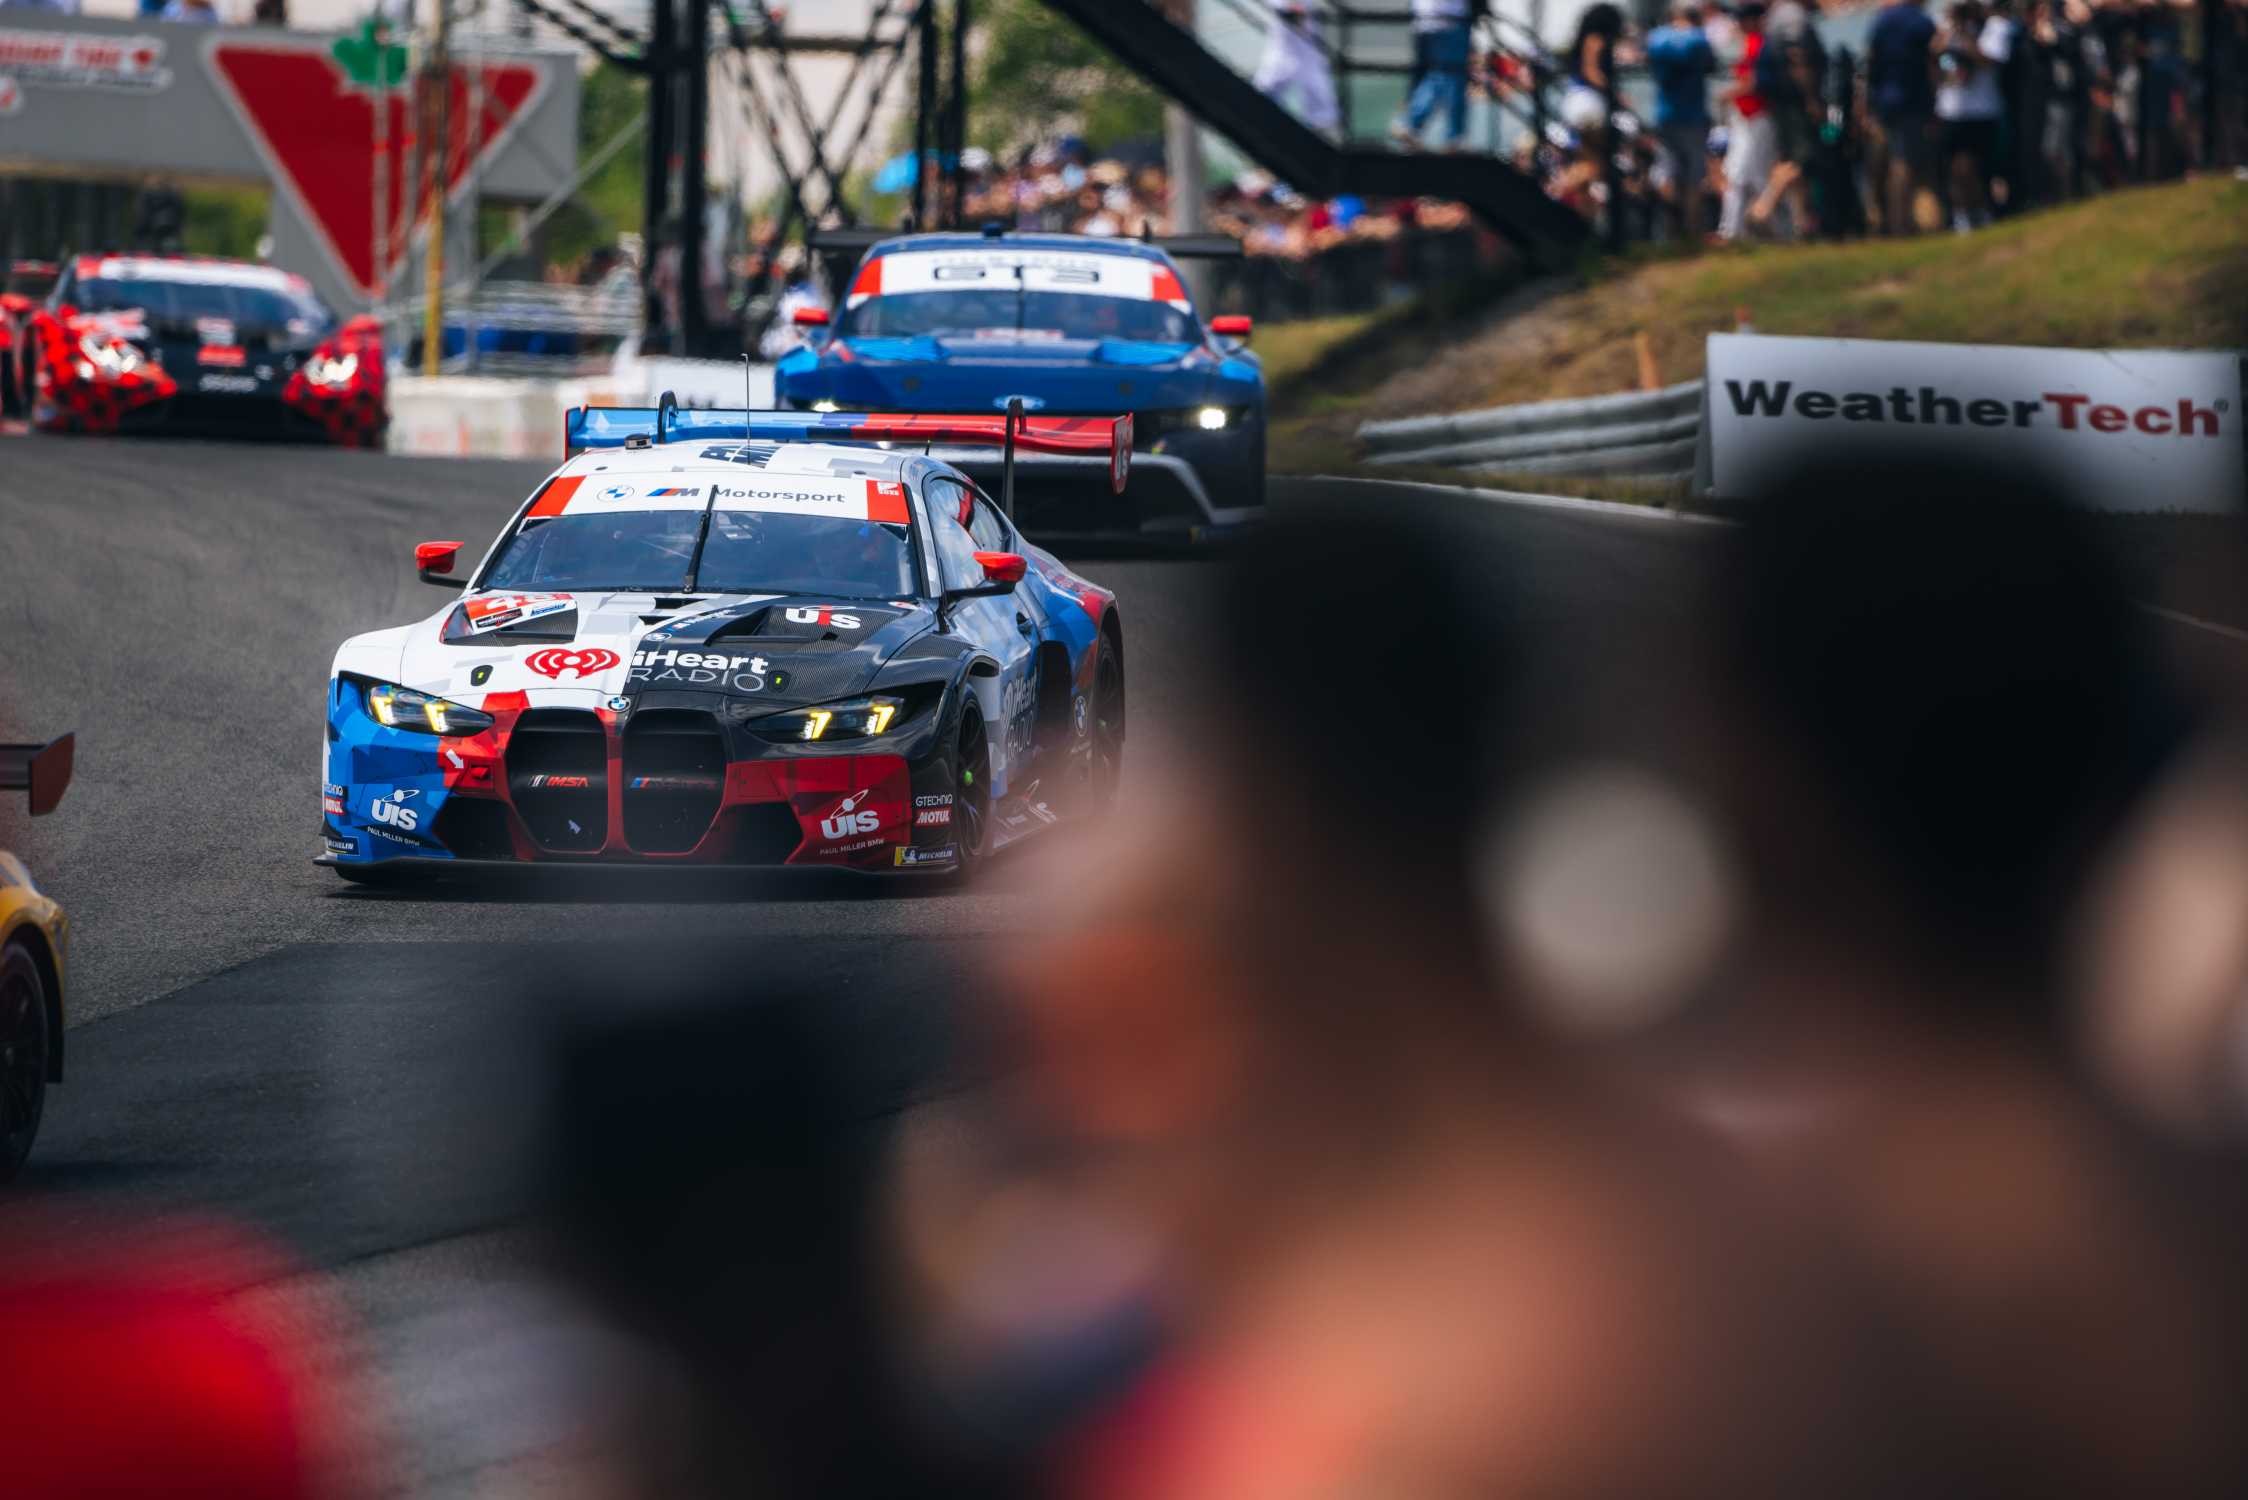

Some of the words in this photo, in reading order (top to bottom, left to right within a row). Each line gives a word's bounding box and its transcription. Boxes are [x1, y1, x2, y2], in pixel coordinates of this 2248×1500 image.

[1725, 380, 2220, 437] WeatherTech
[715, 486, 846, 503] Motorsport
[631, 649, 769, 675] iHeart
[626, 668, 764, 692] RADIO
[546, 776, 589, 788] IMSA
[917, 810, 950, 824] MOTUL
[381, 831, 403, 844] MILLER
[840, 842, 866, 853] MILLER
